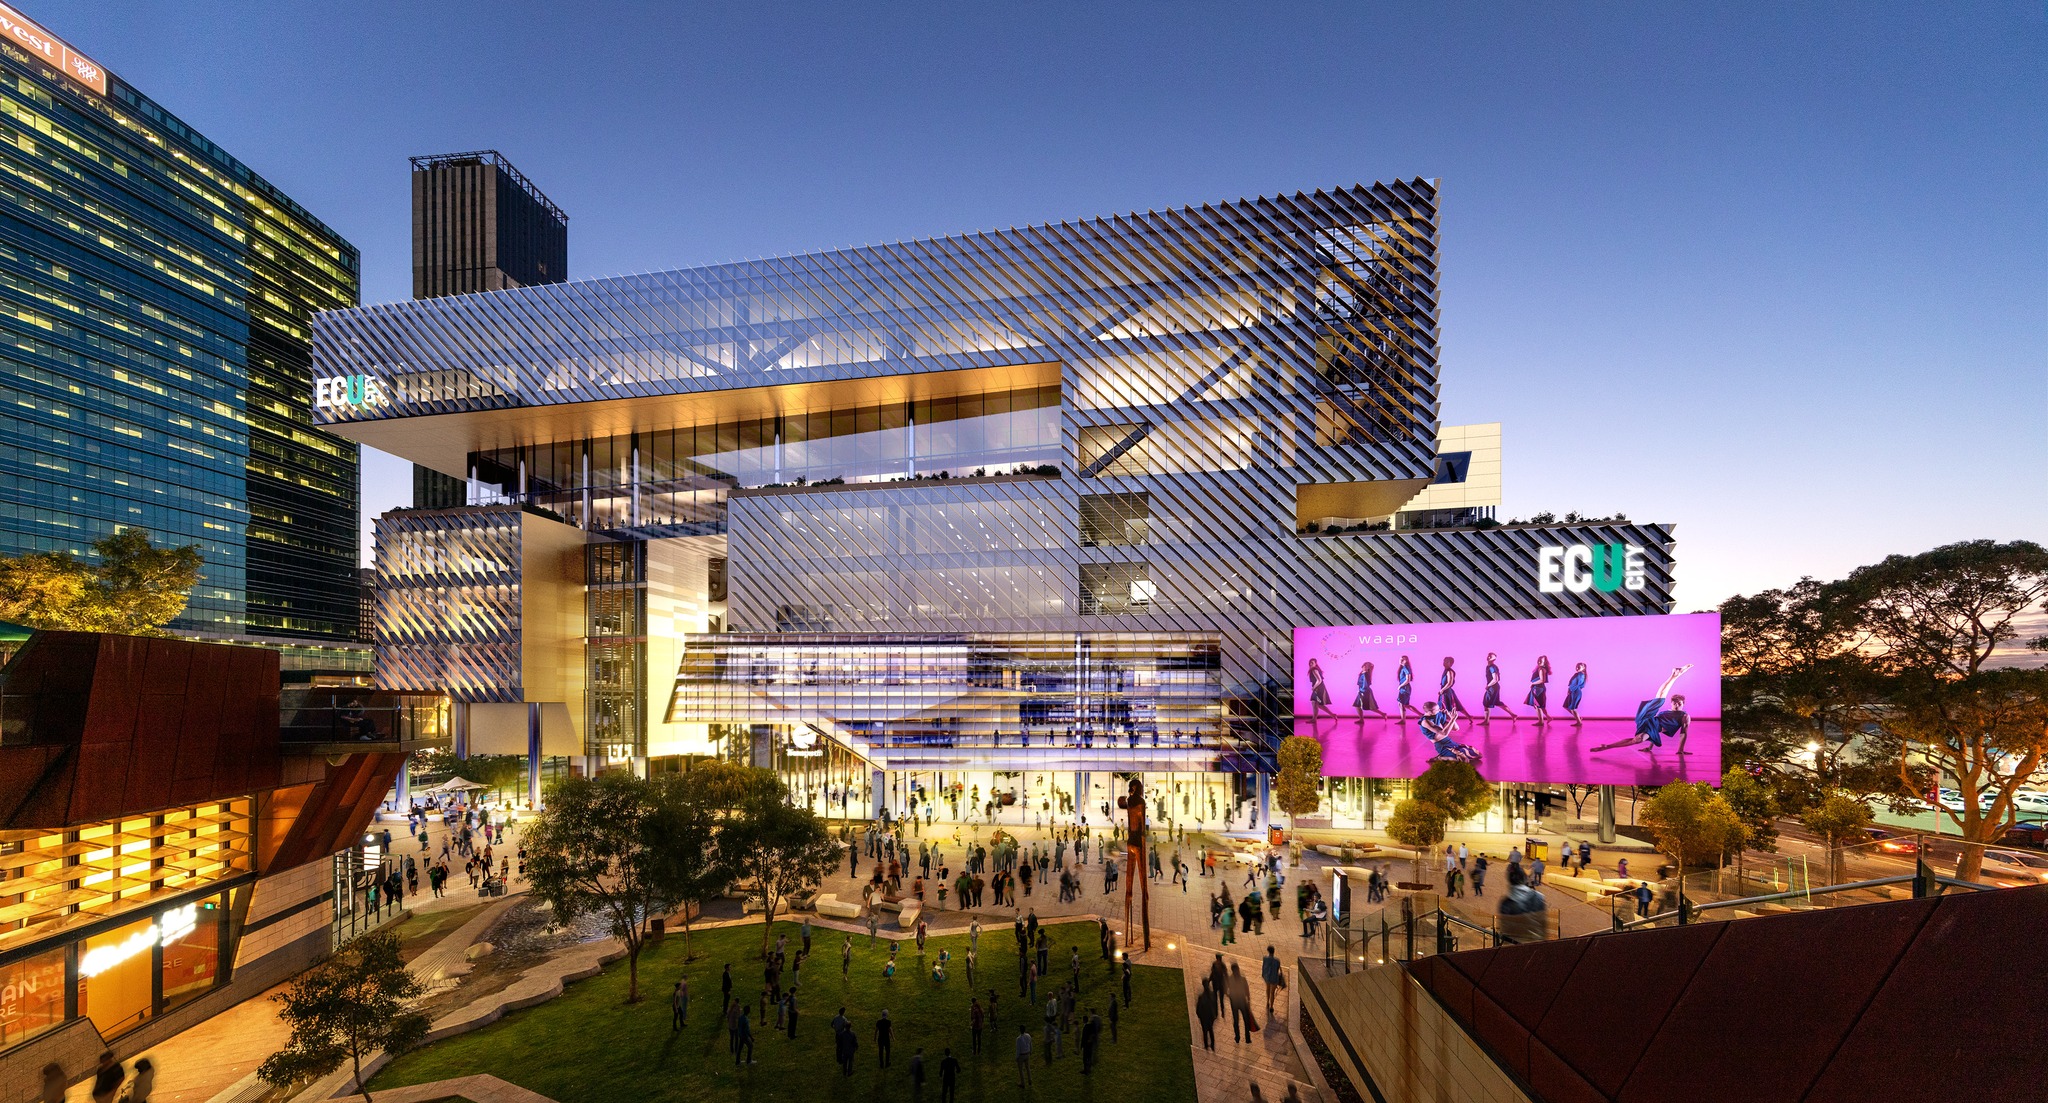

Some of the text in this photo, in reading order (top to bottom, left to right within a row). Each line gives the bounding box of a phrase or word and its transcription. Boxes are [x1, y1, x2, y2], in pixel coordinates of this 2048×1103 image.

[317, 375, 364, 408] ECU
[1539, 543, 1645, 593] ECU CITY
[1359, 634, 1417, 645] waapa
